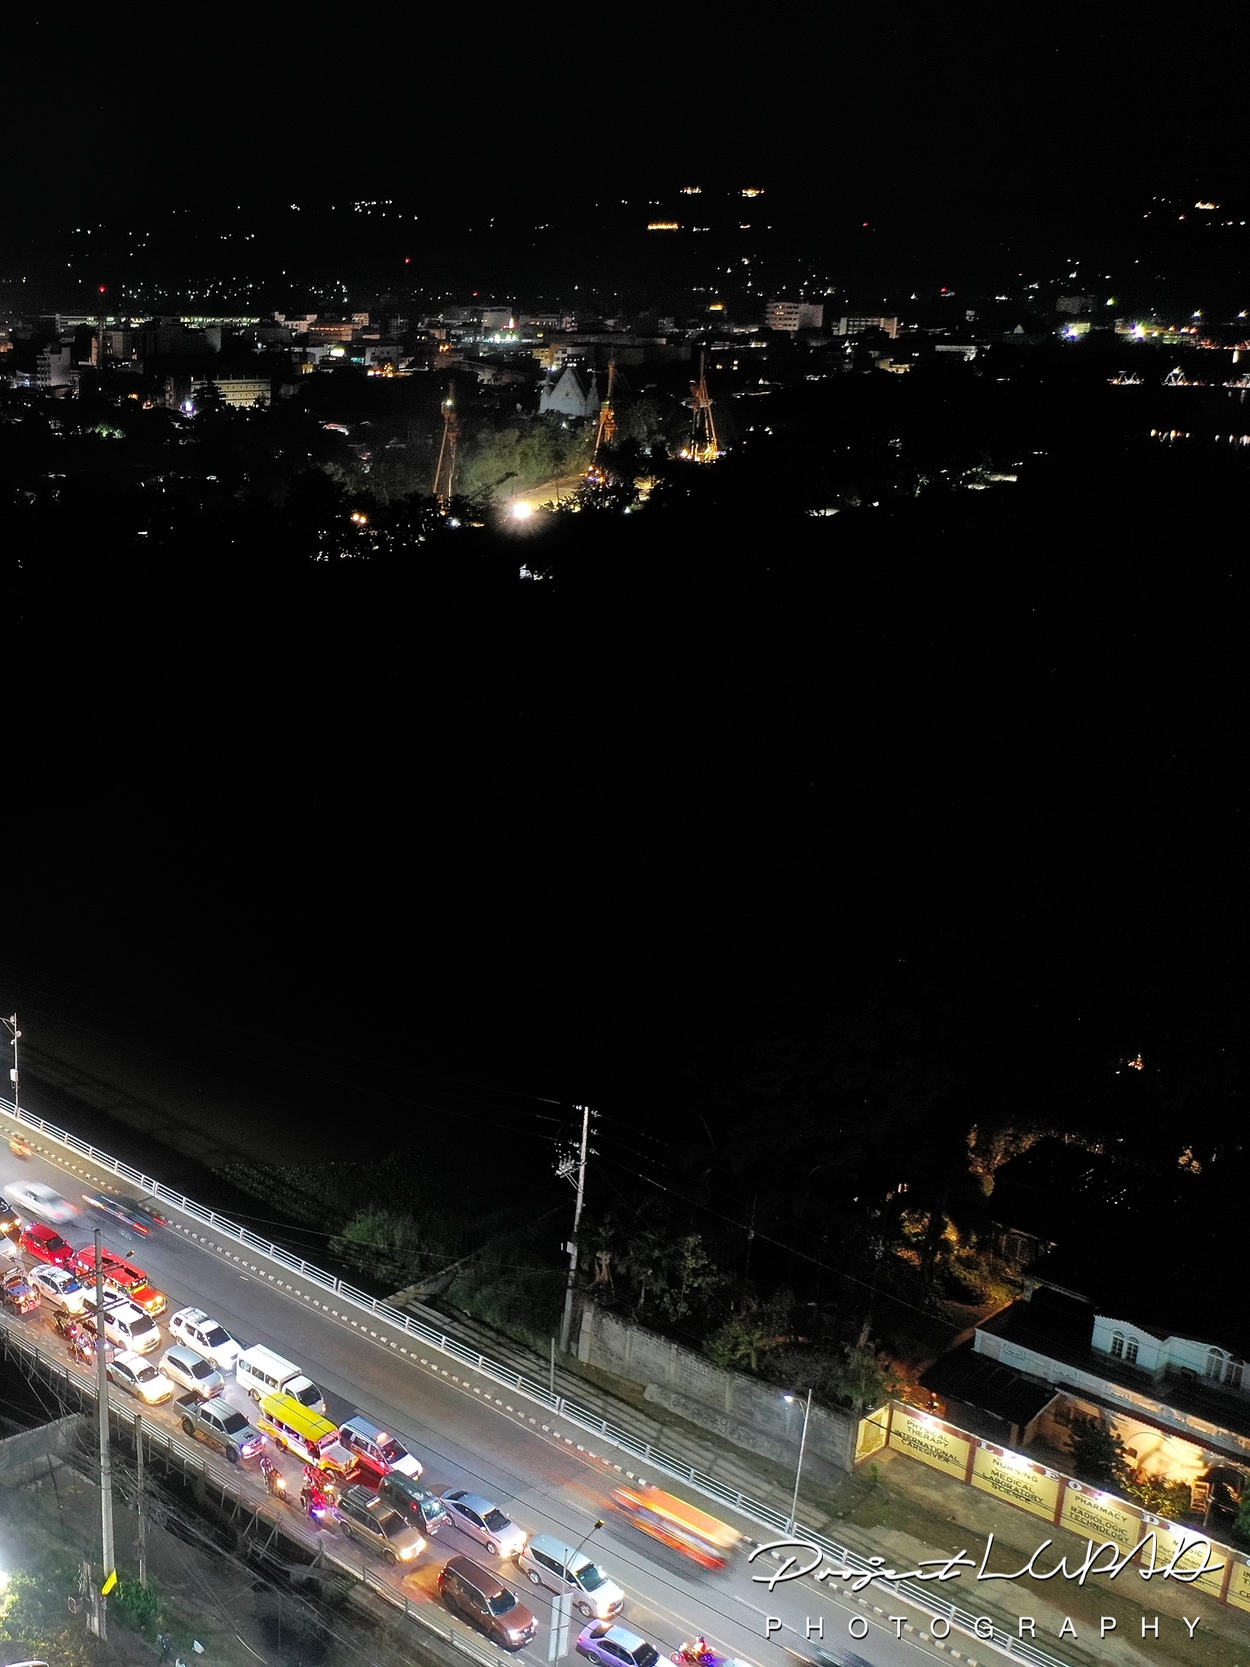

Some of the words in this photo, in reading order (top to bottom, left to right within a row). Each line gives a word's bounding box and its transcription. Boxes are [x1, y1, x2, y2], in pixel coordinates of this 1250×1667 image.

[894, 1429, 960, 1463] INTERNATIONAL
[906, 1426, 950, 1448] THERAPY
[901, 1439, 950, 1464] CAREGIVER
[990, 1469, 1035, 1493] MEDICAL
[992, 1458, 1038, 1483] NURSING
[982, 1472, 1044, 1503] LABORATORY
[991, 1482, 1032, 1505] SCIENCE
[1070, 1506, 1128, 1536] RADIOLOGIC
[1074, 1495, 1128, 1522] PHARMACY
[1069, 1512, 1129, 1543] TECHNOLOGY
